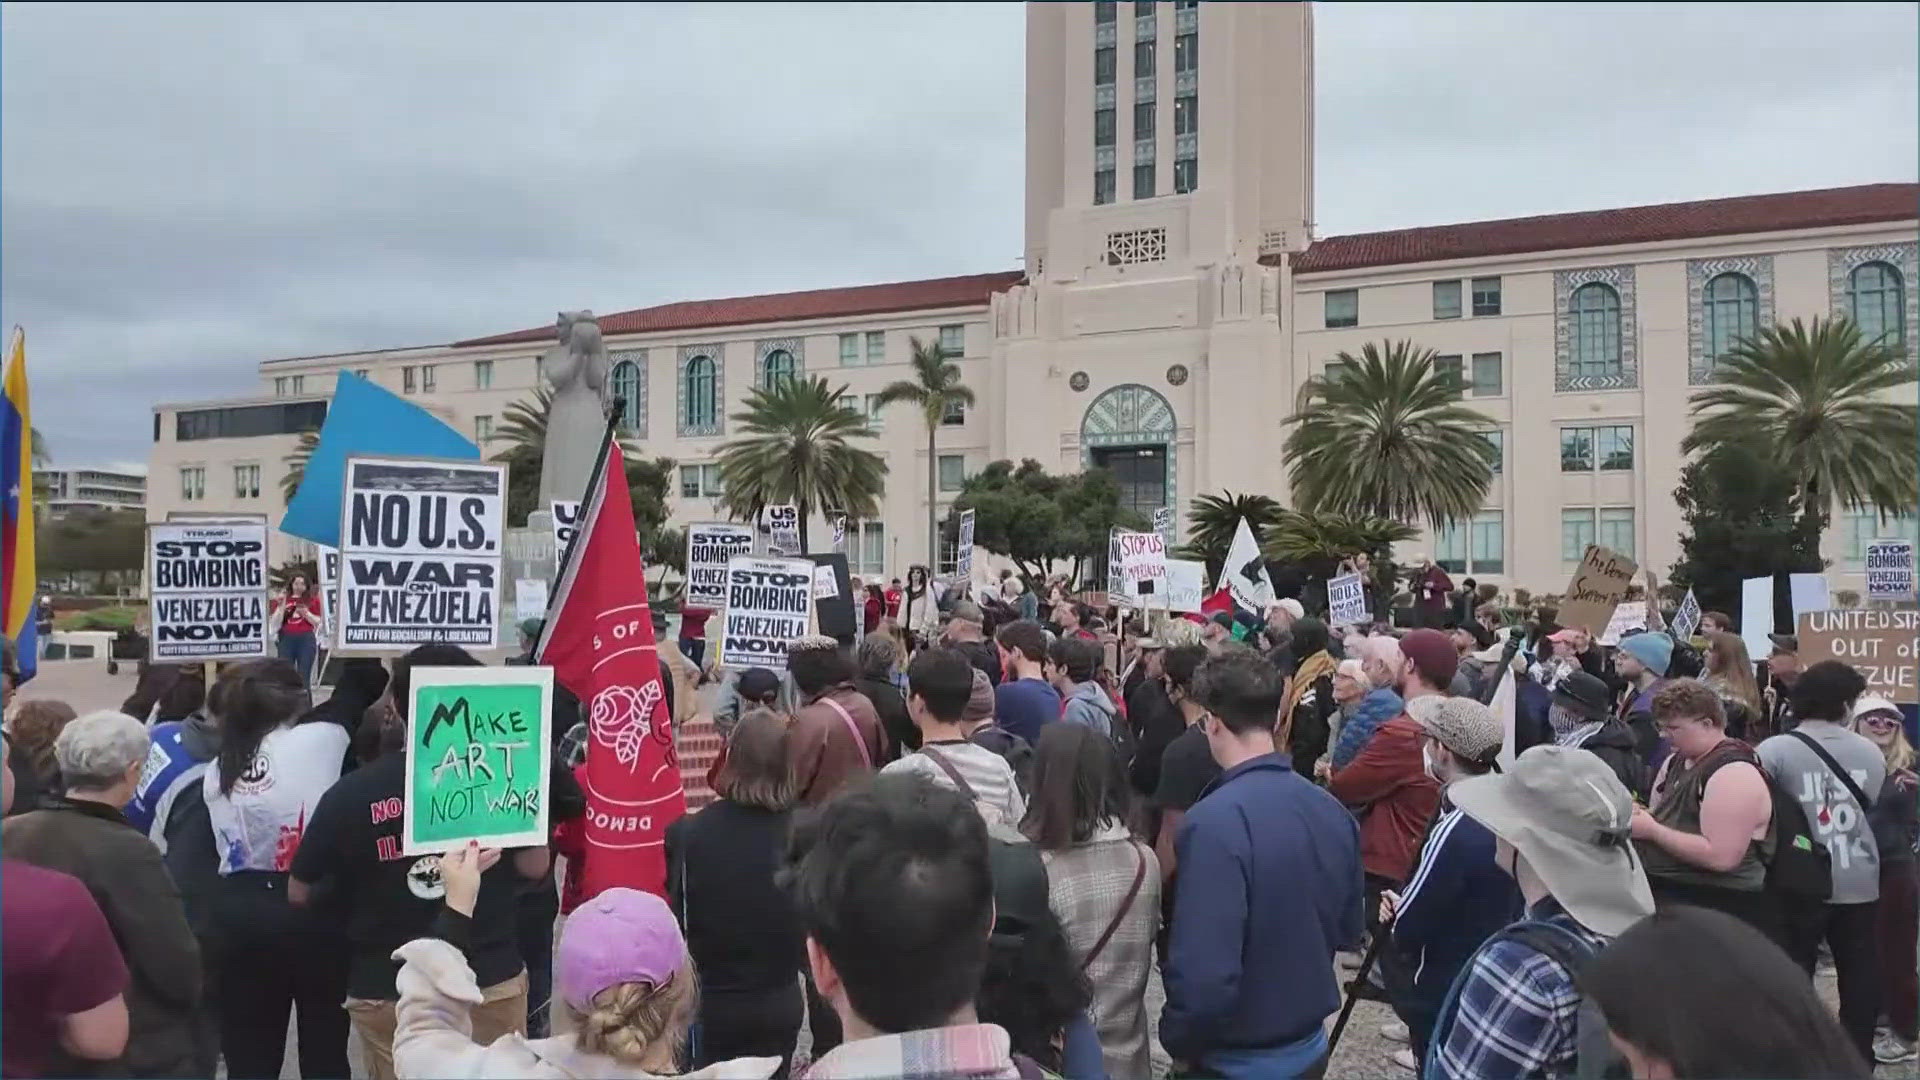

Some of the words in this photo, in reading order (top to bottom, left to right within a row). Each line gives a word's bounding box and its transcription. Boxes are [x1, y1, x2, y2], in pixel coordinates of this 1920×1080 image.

[351, 493, 410, 548] NO
[418, 495, 495, 550] U.S.
[770, 507, 796, 519] US
[771, 521, 796, 529] OUT
[156, 541, 262, 557] STOP
[692, 534, 752, 544] STOP
[1122, 535, 1146, 557] STOP
[1148, 535, 1163, 554] US
[1868, 545, 1910, 554] STOP
[1868, 554, 1911, 568] BOMBING
[157, 558, 261, 588] BOMBING
[350, 560, 494, 588] WAR
[731, 571, 810, 588] STOP
[1868, 571, 1912, 583] VENEZUELA
[409, 583, 434, 592] ON
[1330, 587, 1343, 602] NO
[157, 597, 262, 622] VENEZUELA
[347, 589, 492, 624] VENEZUELA
[730, 585, 808, 613] BOMBING
[158, 623, 262, 641] NOW!
[612, 620, 640, 640] OF
[727, 615, 805, 638] VENEZUELA
[1810, 611, 1889, 632] UNITED
[348, 629, 373, 641] PARTY
[374, 629, 391, 641] FOR
[391, 630, 432, 641] SOCIALISM
[444, 630, 490, 642] LIBERATION
[1831, 637, 1884, 659] OUT
[422, 696, 529, 748] MAKE
[432, 741, 531, 782] ART
[370, 797, 402, 824] NO
[430, 783, 489, 826] NOT
[484, 786, 540, 819] WAR
